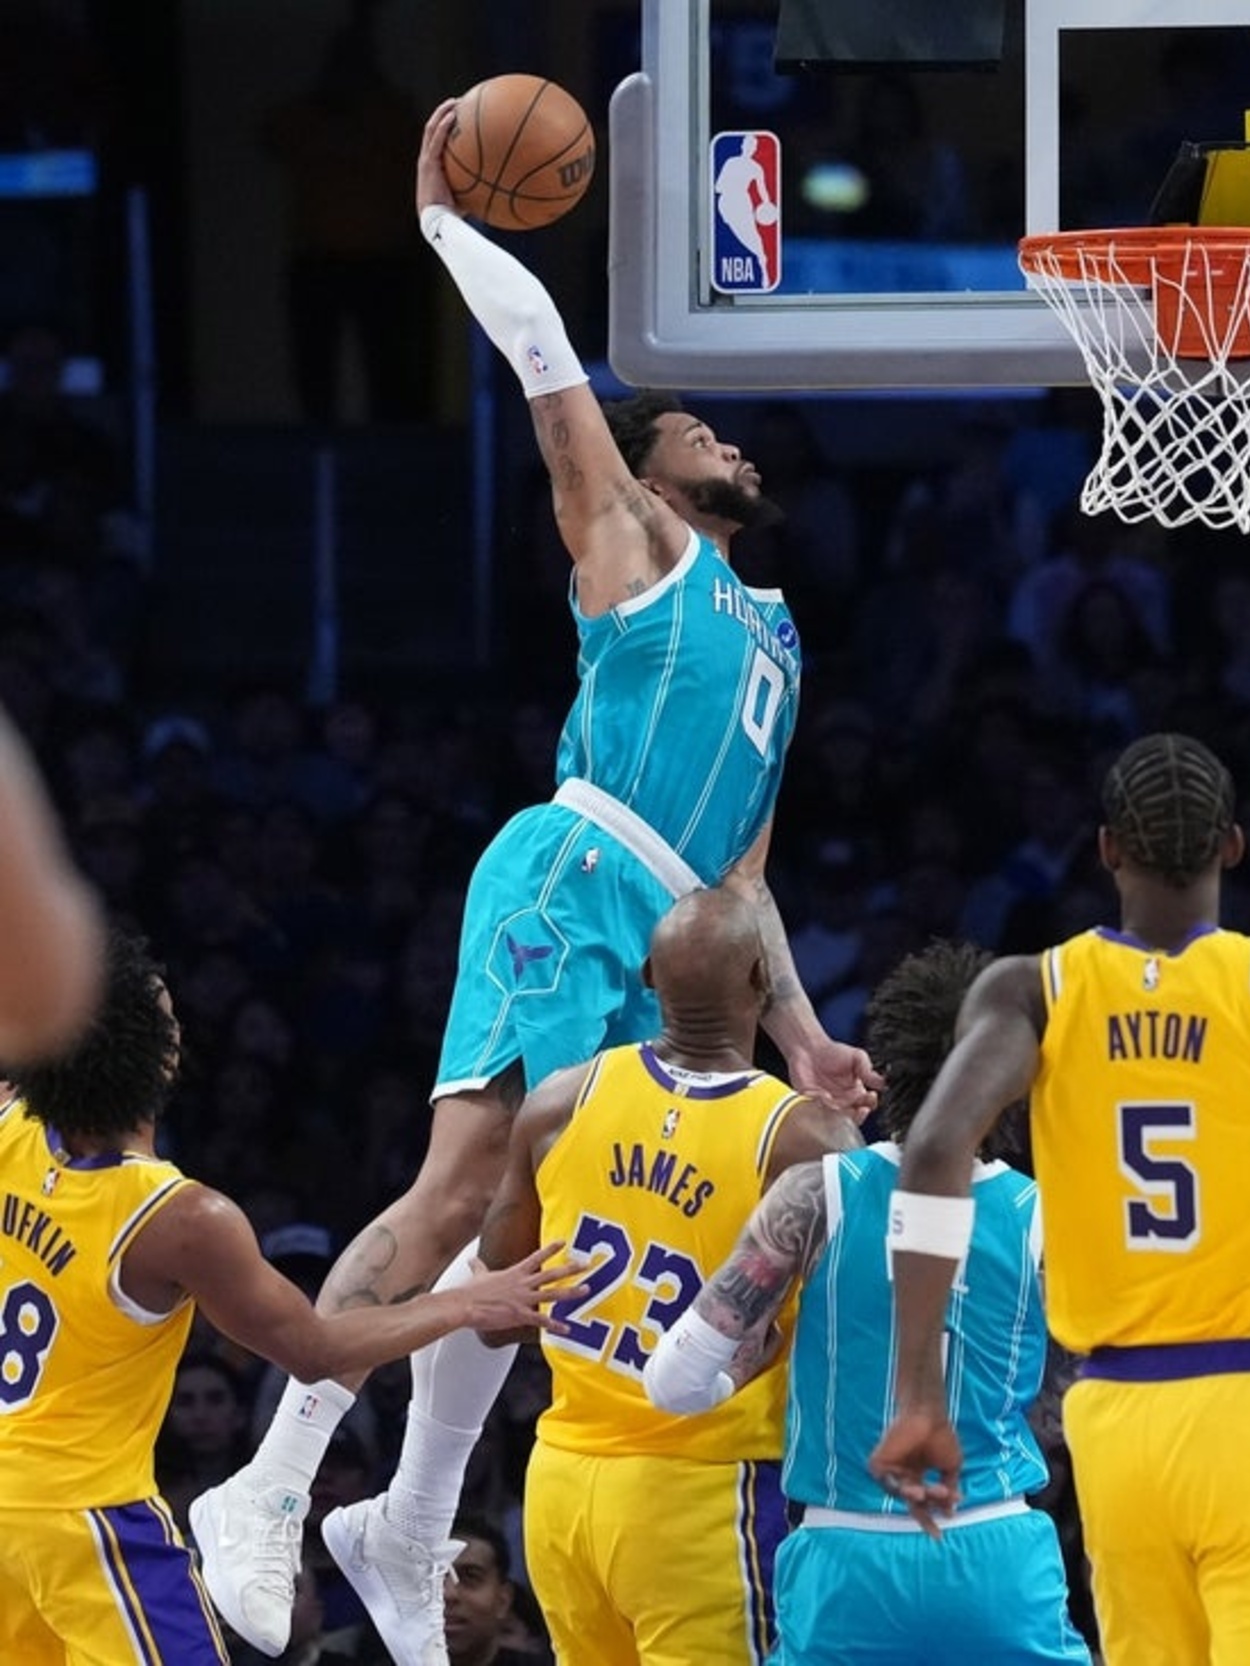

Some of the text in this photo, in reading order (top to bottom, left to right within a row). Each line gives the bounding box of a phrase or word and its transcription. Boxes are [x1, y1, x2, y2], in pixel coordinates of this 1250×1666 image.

[721, 256, 755, 283] NBA
[741, 647, 786, 758] 0
[1107, 1010, 1208, 1064] AYTON
[609, 1142, 716, 1219] JAMES
[1114, 1098, 1202, 1254] 5
[3, 1192, 76, 1277] UFKIN
[547, 1212, 704, 1378] 23
[0, 1278, 60, 1415] 8
